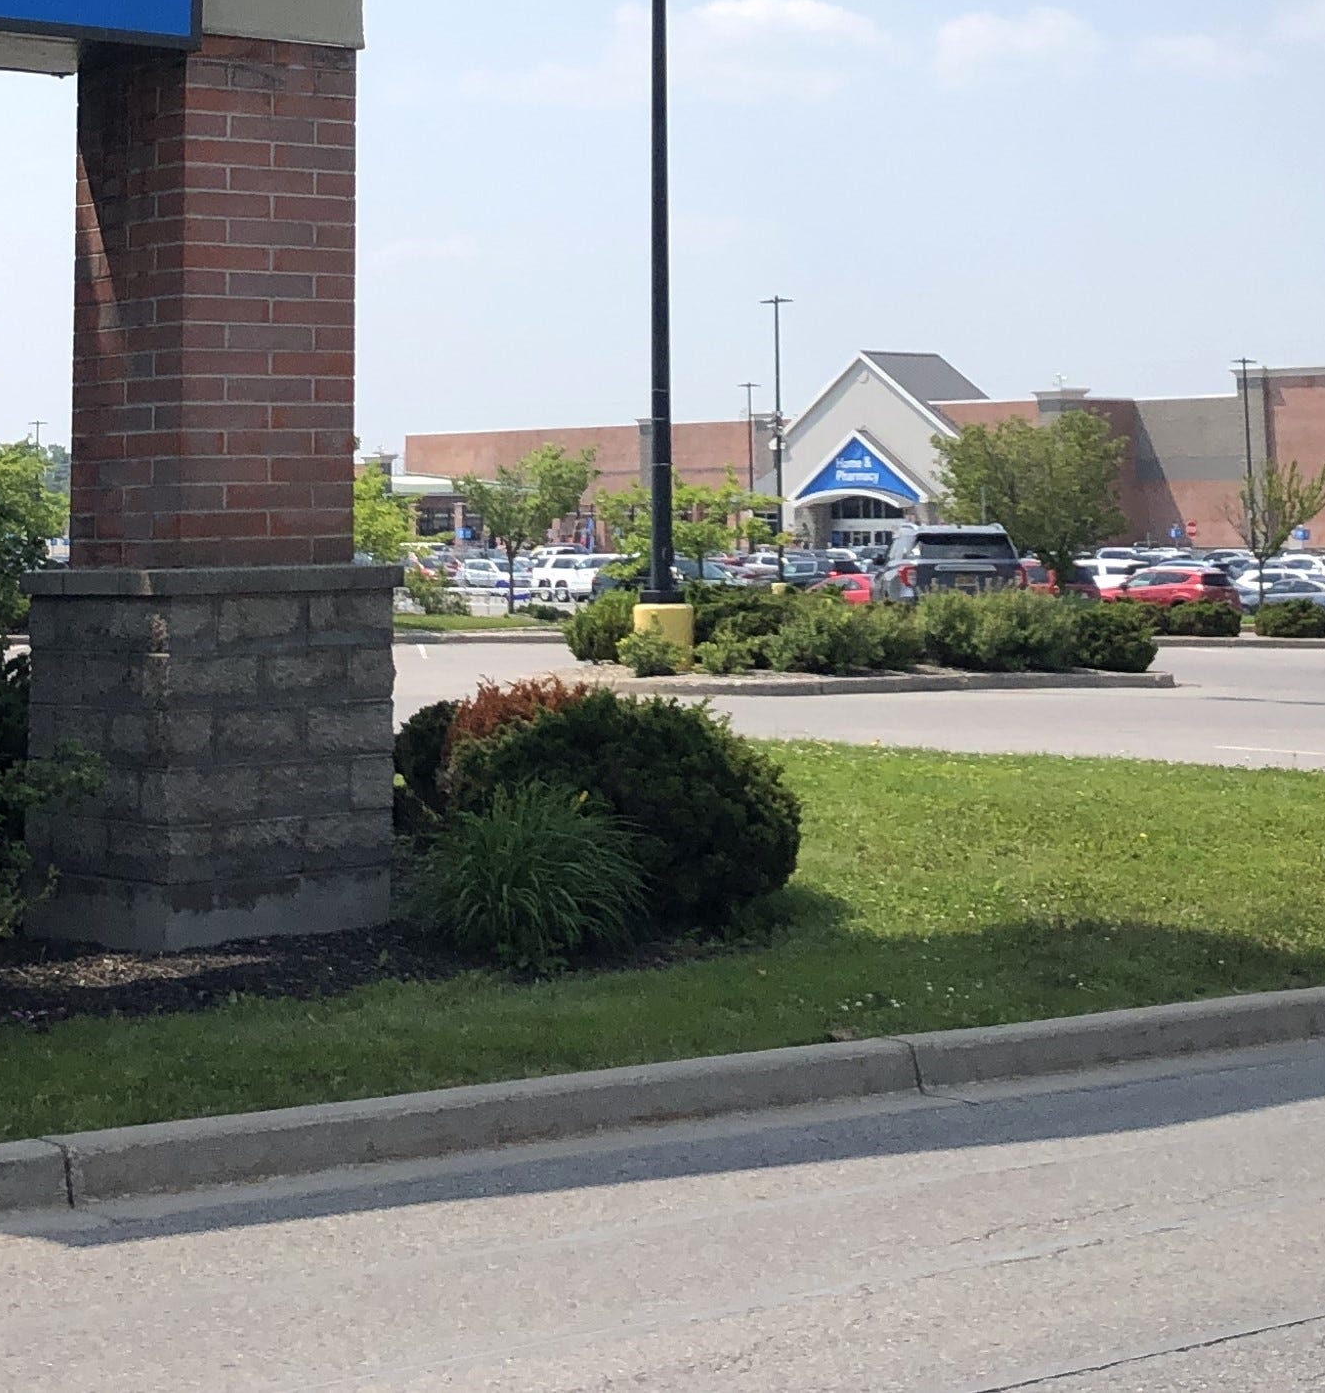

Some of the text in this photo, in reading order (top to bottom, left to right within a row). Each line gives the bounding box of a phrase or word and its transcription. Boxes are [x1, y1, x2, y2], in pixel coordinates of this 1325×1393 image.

[836, 456, 873, 468] Home &
[836, 471, 879, 484] Pharmacy
